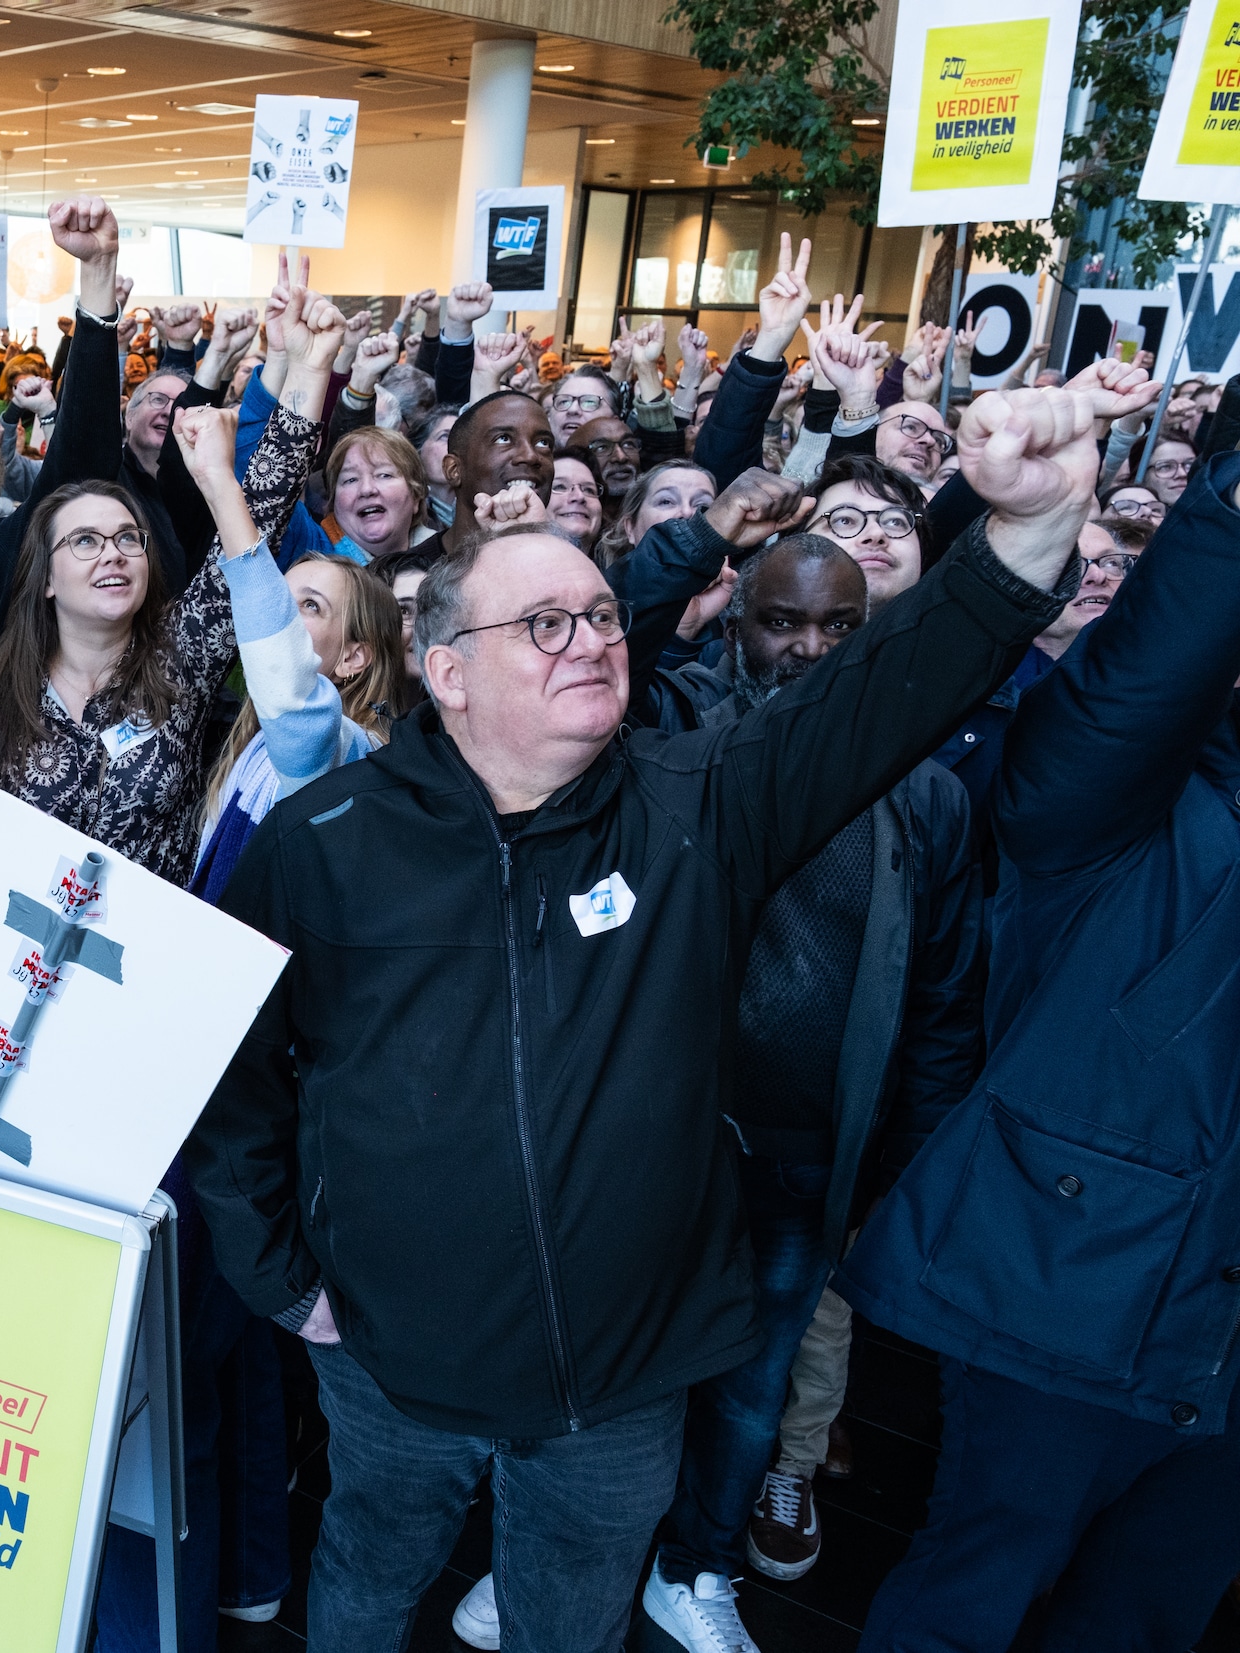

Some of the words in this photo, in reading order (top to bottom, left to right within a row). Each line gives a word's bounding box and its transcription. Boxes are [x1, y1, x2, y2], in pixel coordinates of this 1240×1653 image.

[940, 58, 966, 79] FNV
[1216, 69, 1240, 87] VE
[963, 73, 1016, 88] Personeel
[937, 95, 1020, 118] VERDIENT
[935, 117, 1016, 140] WERKEN
[1203, 114, 1217, 130] in
[932, 143, 945, 159] in
[949, 138, 1013, 160] veiligheid
[496, 223, 537, 245] WTF
